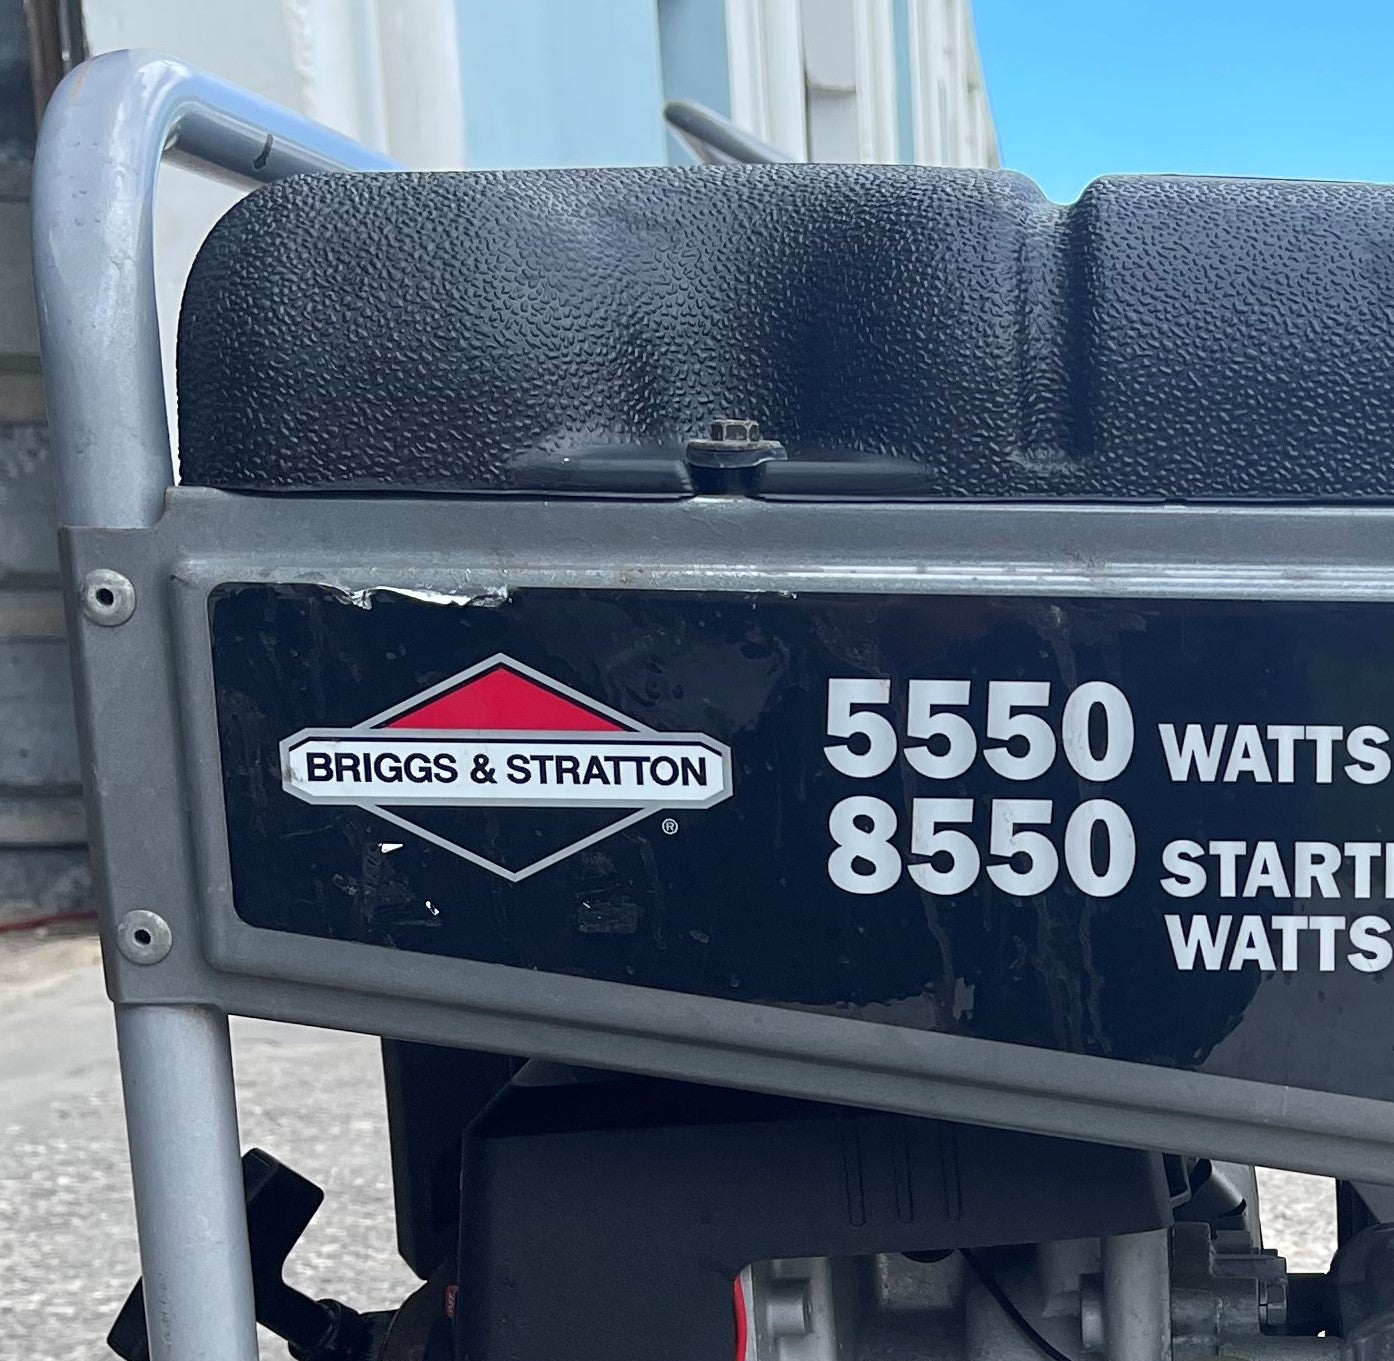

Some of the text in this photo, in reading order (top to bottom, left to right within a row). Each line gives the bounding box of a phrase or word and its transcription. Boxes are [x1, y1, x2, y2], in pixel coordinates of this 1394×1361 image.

[306, 752, 707, 786] BRIGGS & STRATTON
[824, 679, 1390, 784] 5550 WATTS
[828, 796, 1135, 896] 8550
[1165, 915, 1392, 972] WATTS
